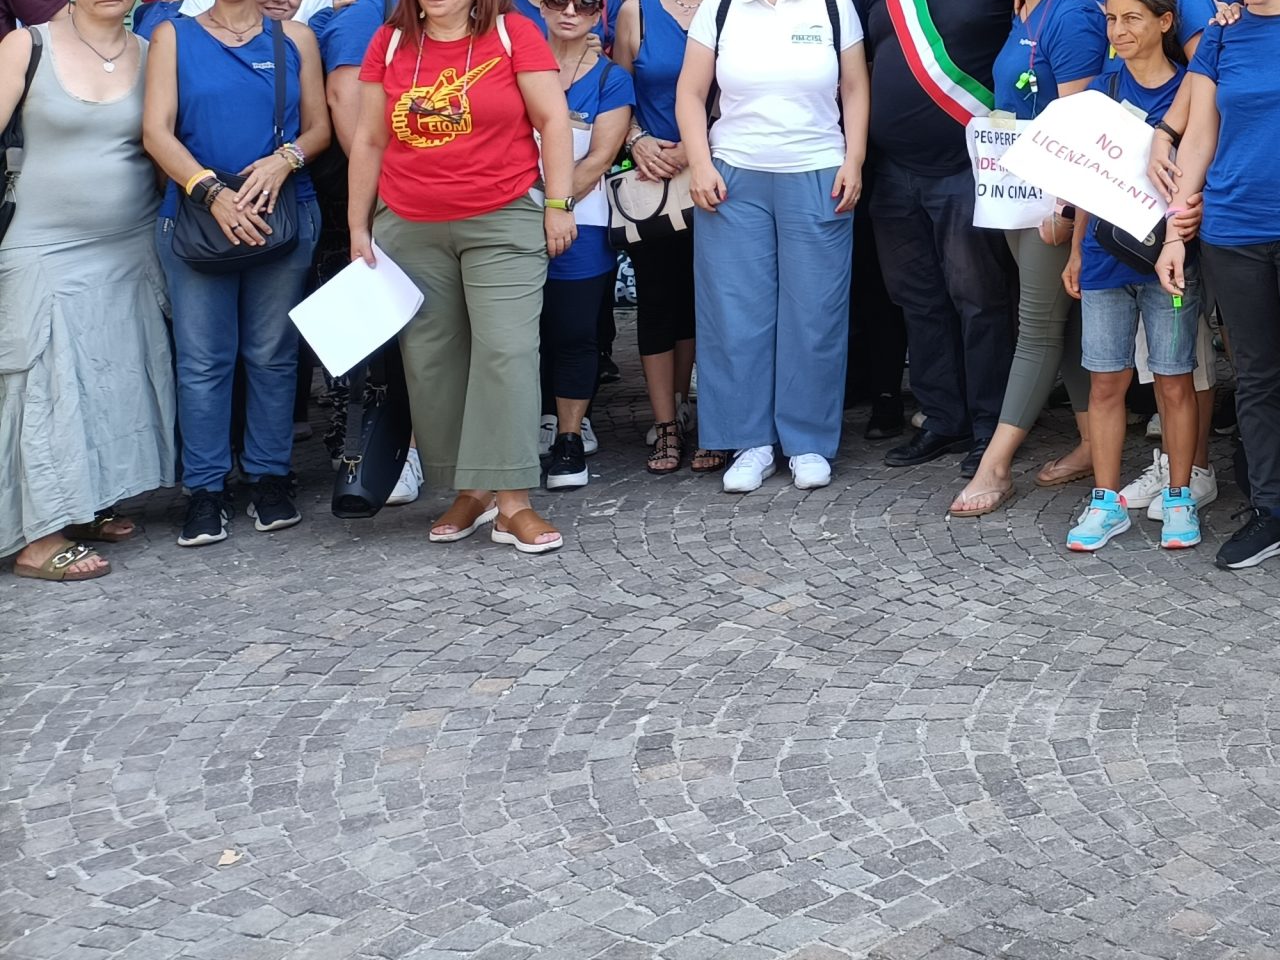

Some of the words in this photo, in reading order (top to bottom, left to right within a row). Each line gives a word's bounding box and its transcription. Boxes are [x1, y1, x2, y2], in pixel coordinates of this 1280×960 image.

[974, 129, 993, 144] PEG
[994, 131, 1022, 147] PERE
[1096, 133, 1123, 160] NO
[1032, 130, 1157, 210] LICENZIAMENTI
[977, 183, 987, 197] O
[990, 184, 1004, 199] IN
[1008, 185, 1043, 200] CINA!
